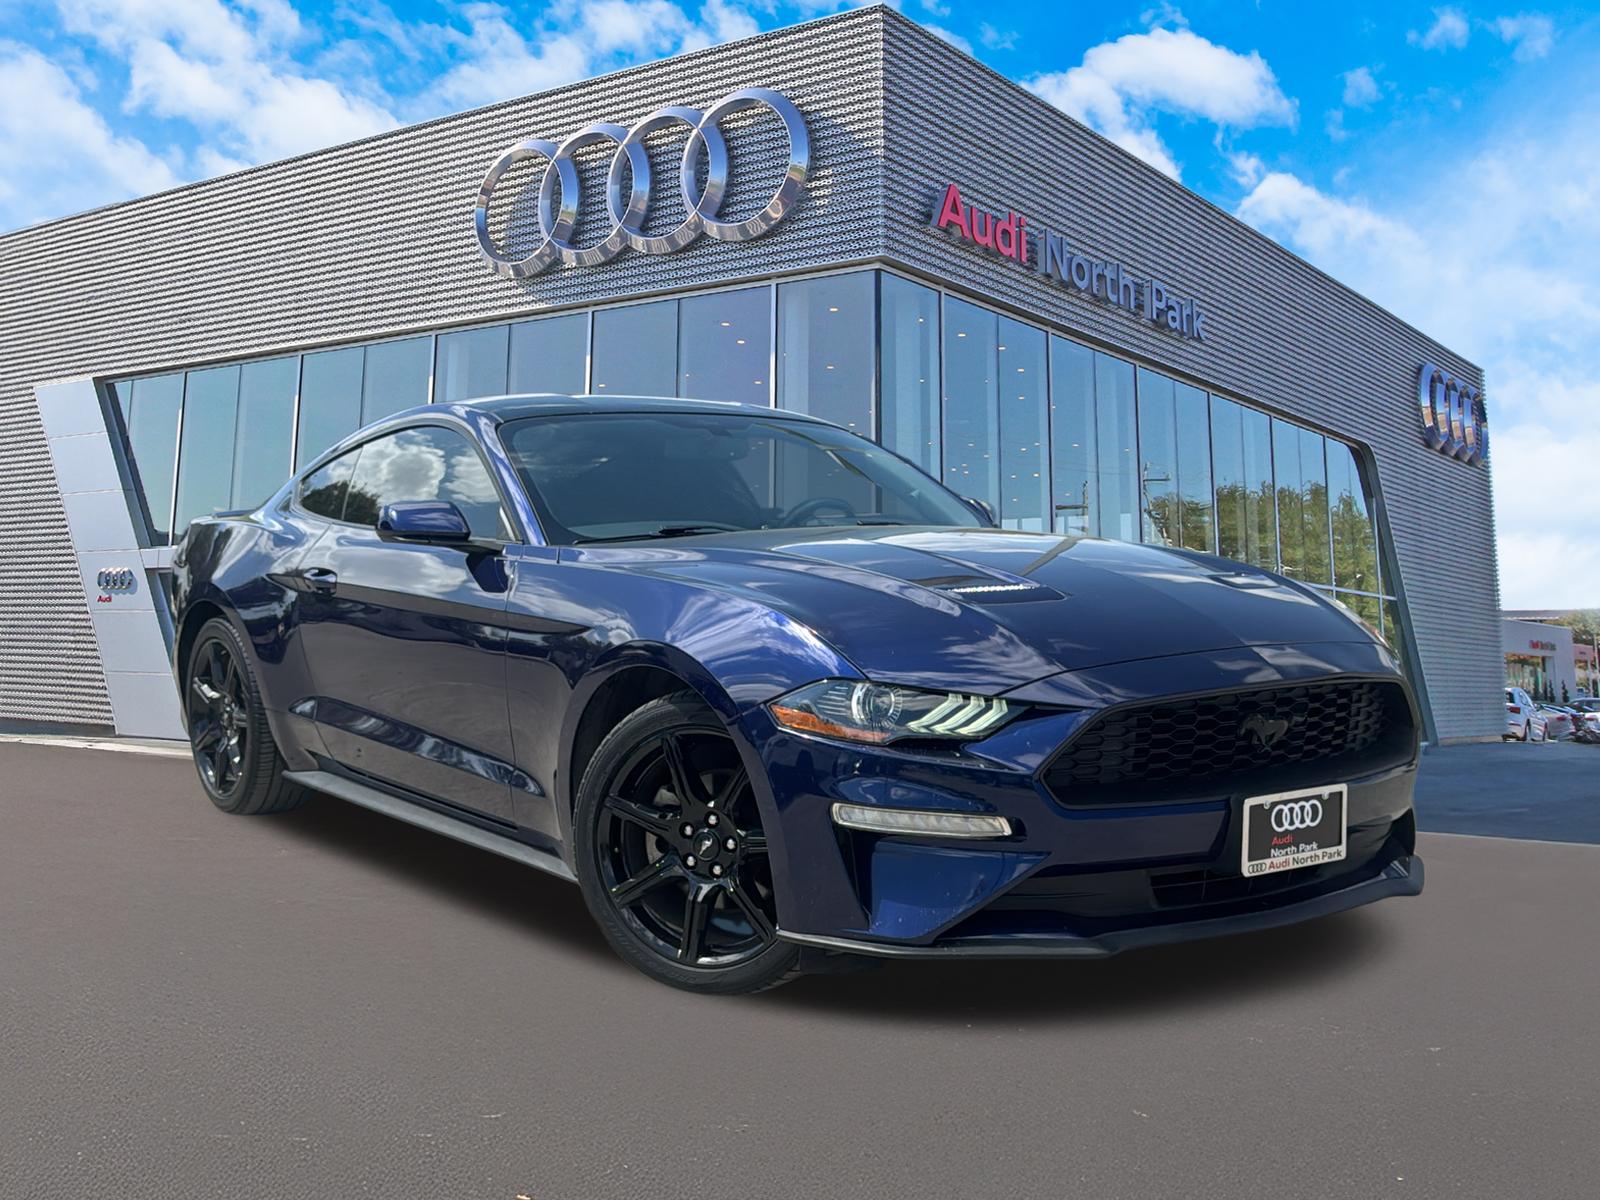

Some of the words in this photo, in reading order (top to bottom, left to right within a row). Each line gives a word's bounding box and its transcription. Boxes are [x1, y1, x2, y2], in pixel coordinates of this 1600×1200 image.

[935, 183, 1027, 263] Audi
[1038, 229, 1137, 311] North
[1144, 279, 1207, 341] Park
[1270, 845, 1297, 857] North
[1299, 841, 1318, 852] Park
[1271, 834, 1293, 845] Audi
[1268, 859, 1291, 871] Audi
[1292, 855, 1320, 866] North
[1321, 849, 1342, 860] Park
